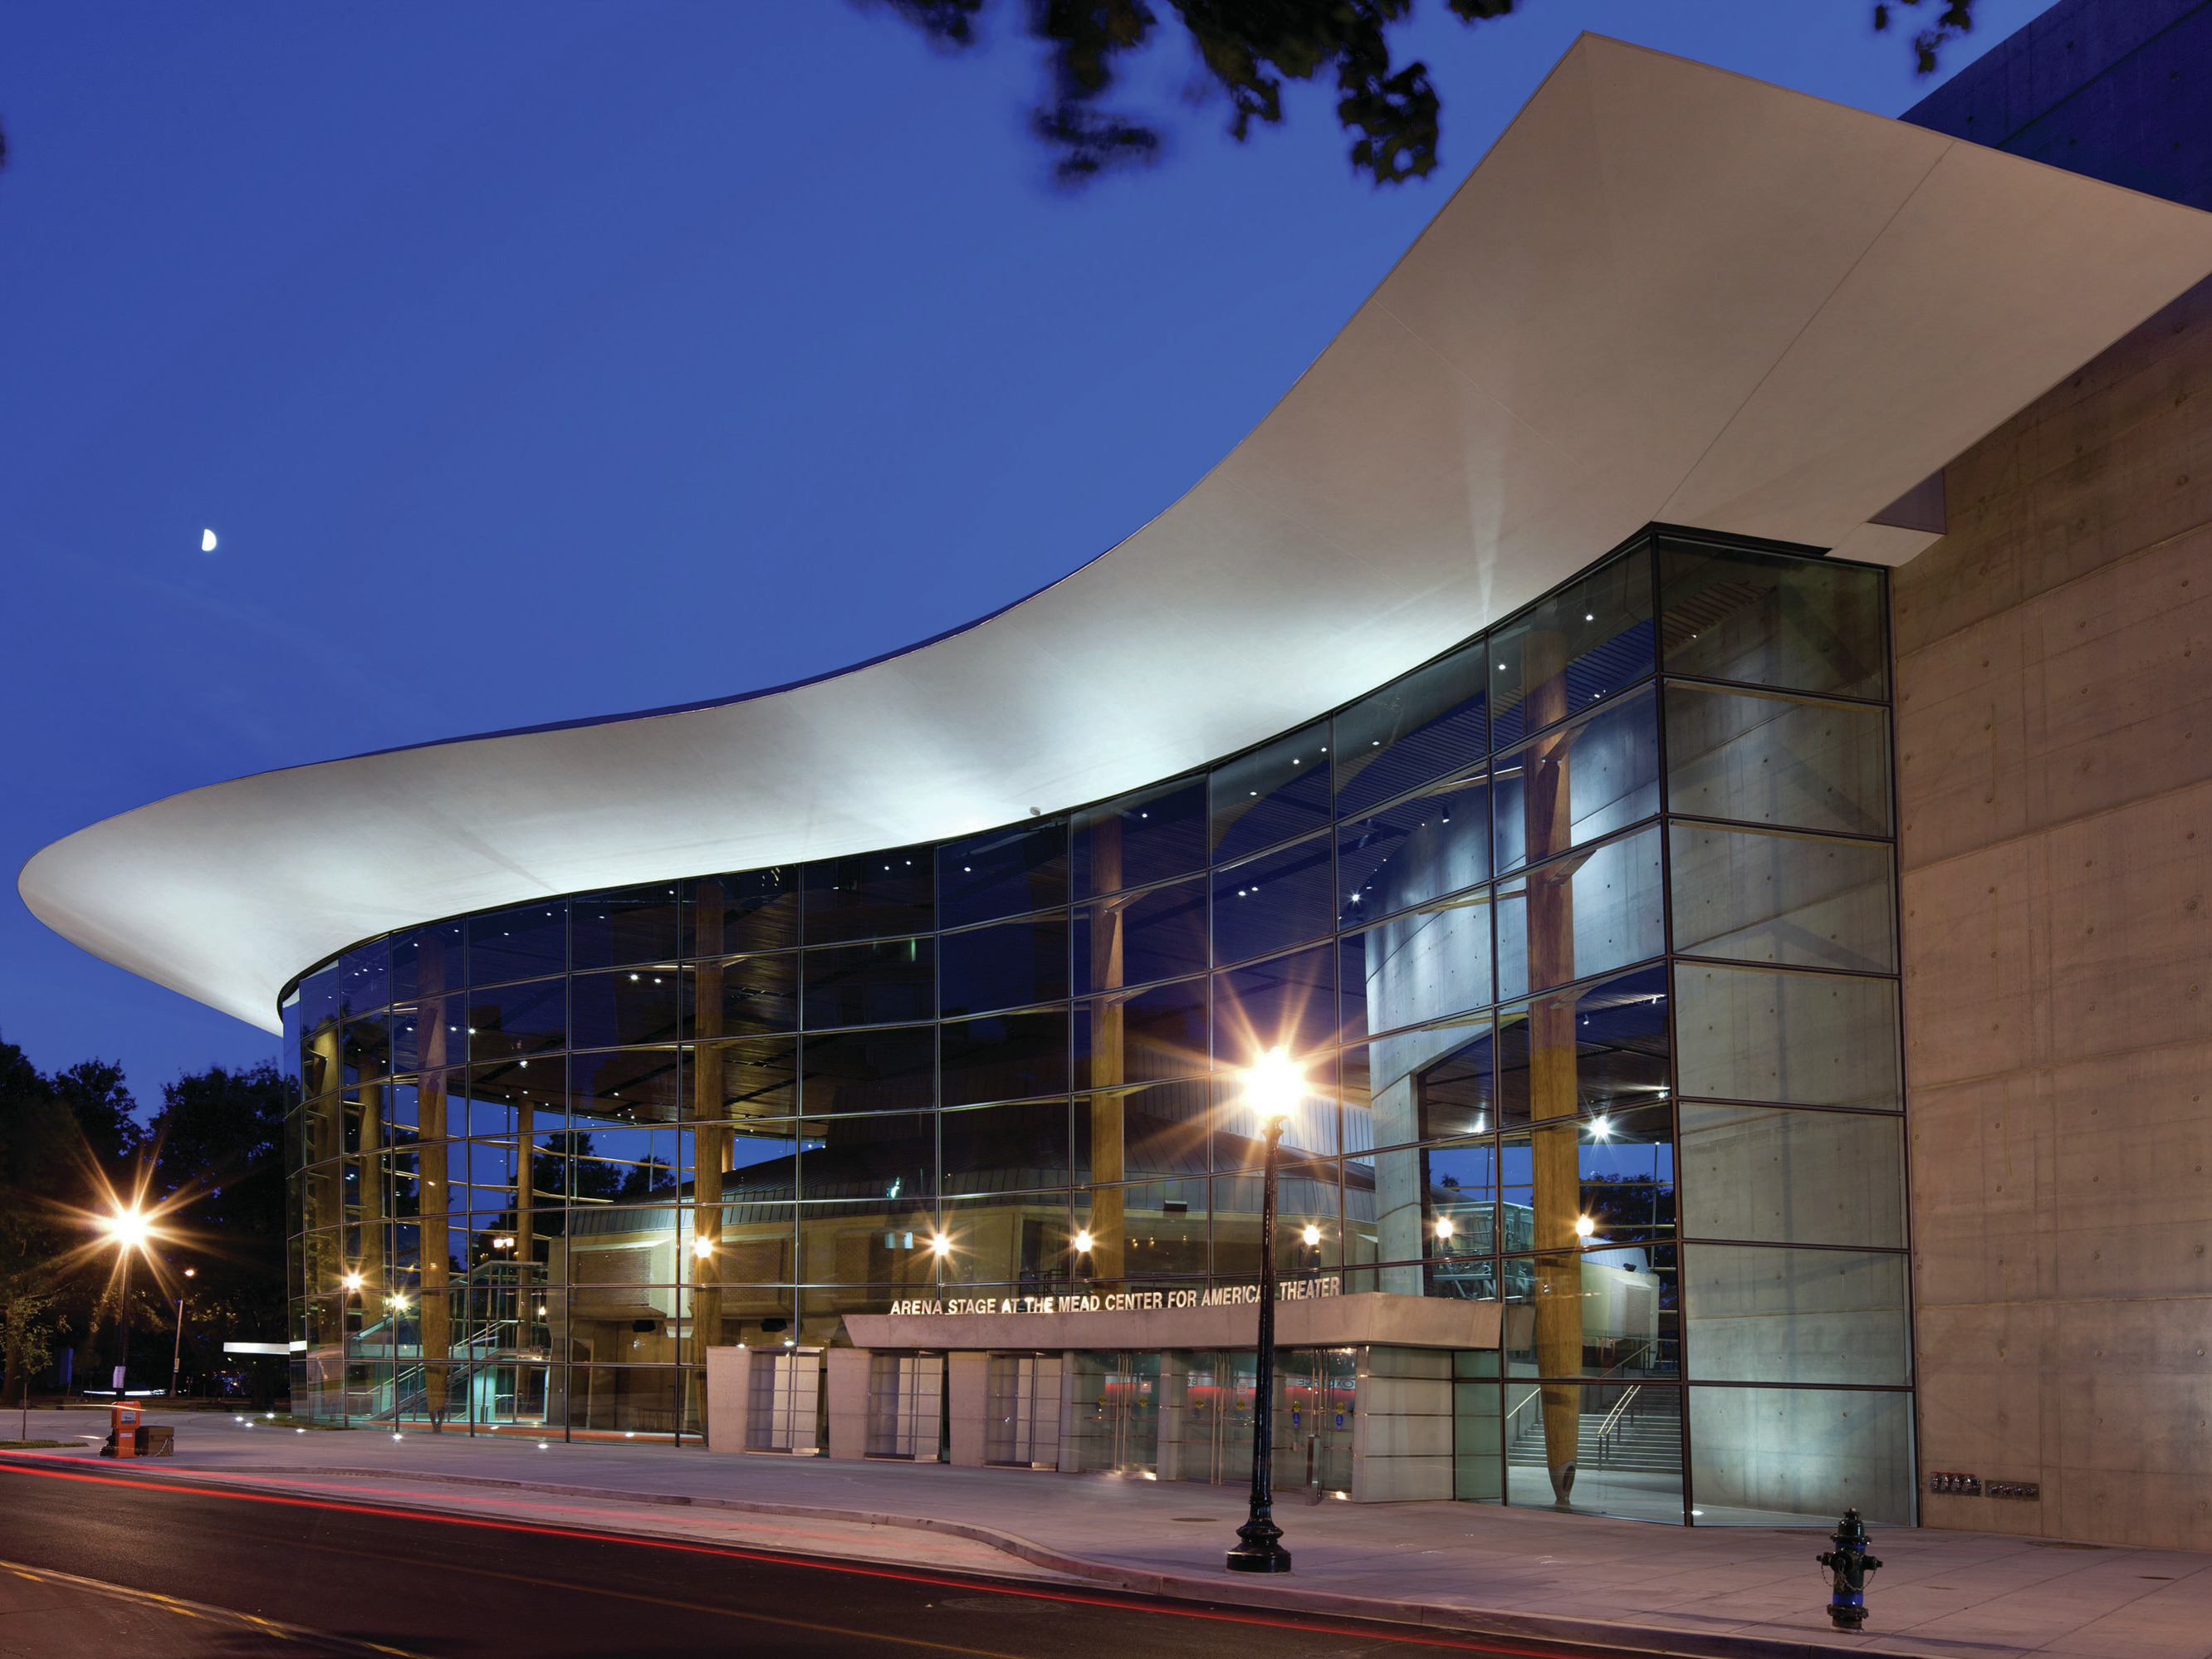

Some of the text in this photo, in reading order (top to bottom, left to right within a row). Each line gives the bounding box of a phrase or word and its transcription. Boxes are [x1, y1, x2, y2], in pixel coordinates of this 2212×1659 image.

[890, 1276, 1341, 1314] ARENA STAGE AT THE MEAD CENTER FOR AMERICA THEATER
